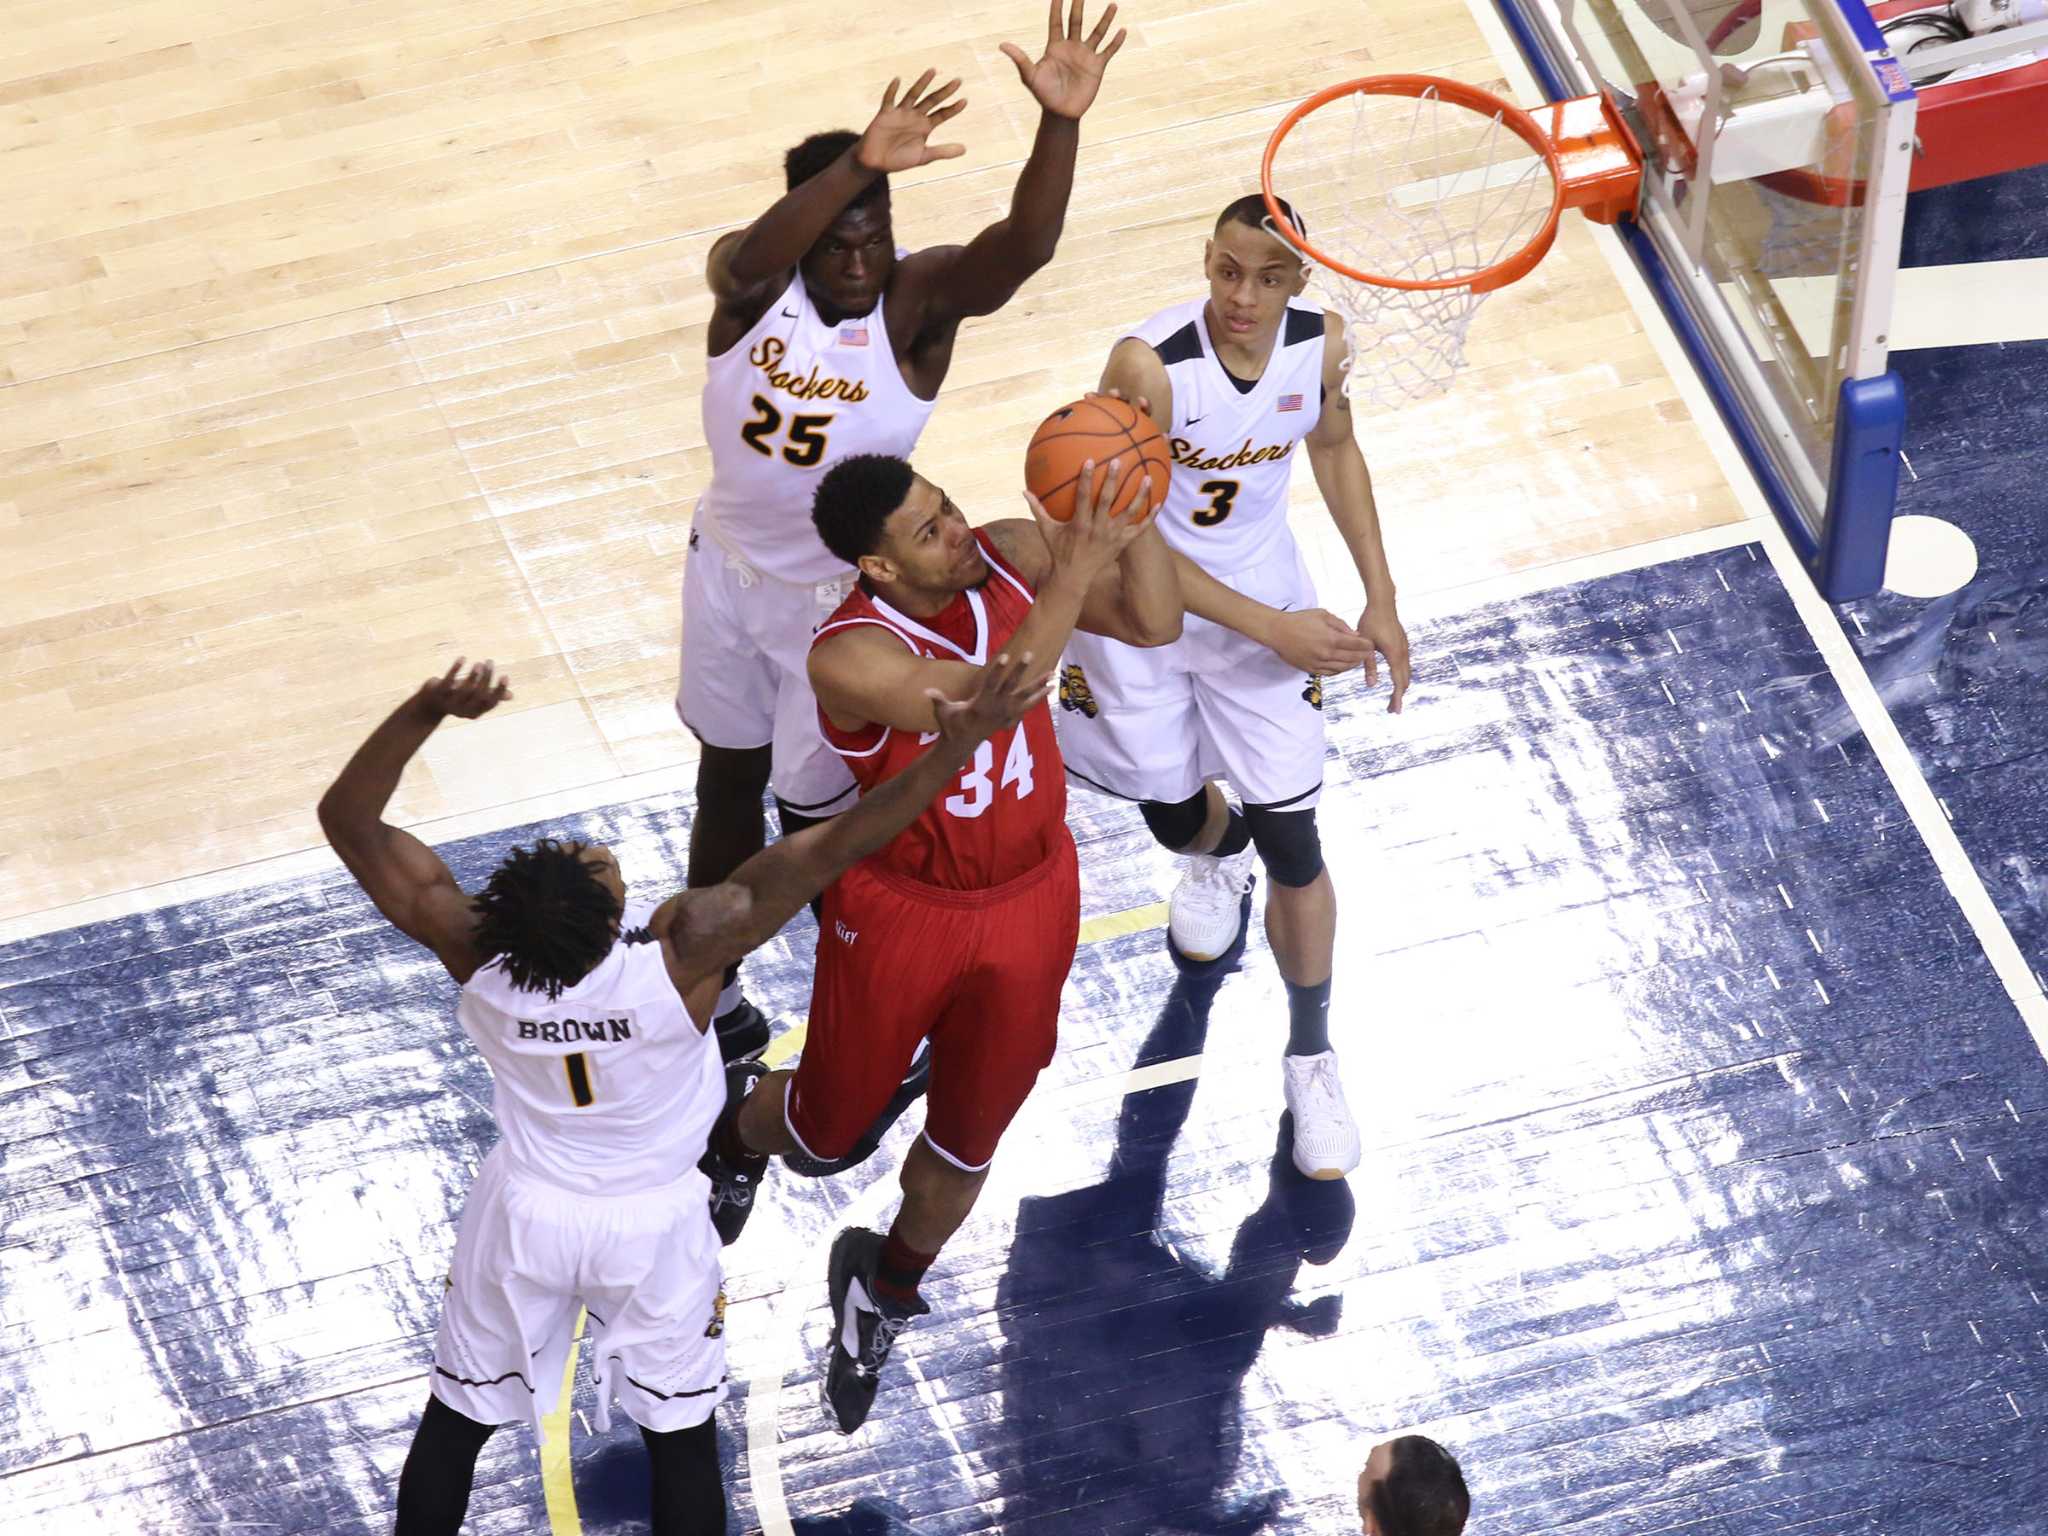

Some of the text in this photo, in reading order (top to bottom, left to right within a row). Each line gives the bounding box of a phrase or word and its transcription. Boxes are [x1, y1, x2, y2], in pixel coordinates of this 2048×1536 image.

[750, 336, 869, 402] Shockers
[740, 394, 834, 468] 25
[1170, 437, 1293, 471] Shockers
[1190, 480, 1241, 528] 3
[945, 719, 1034, 819] 34
[517, 1018, 632, 1043] BROWN
[563, 1052, 596, 1107] 1
